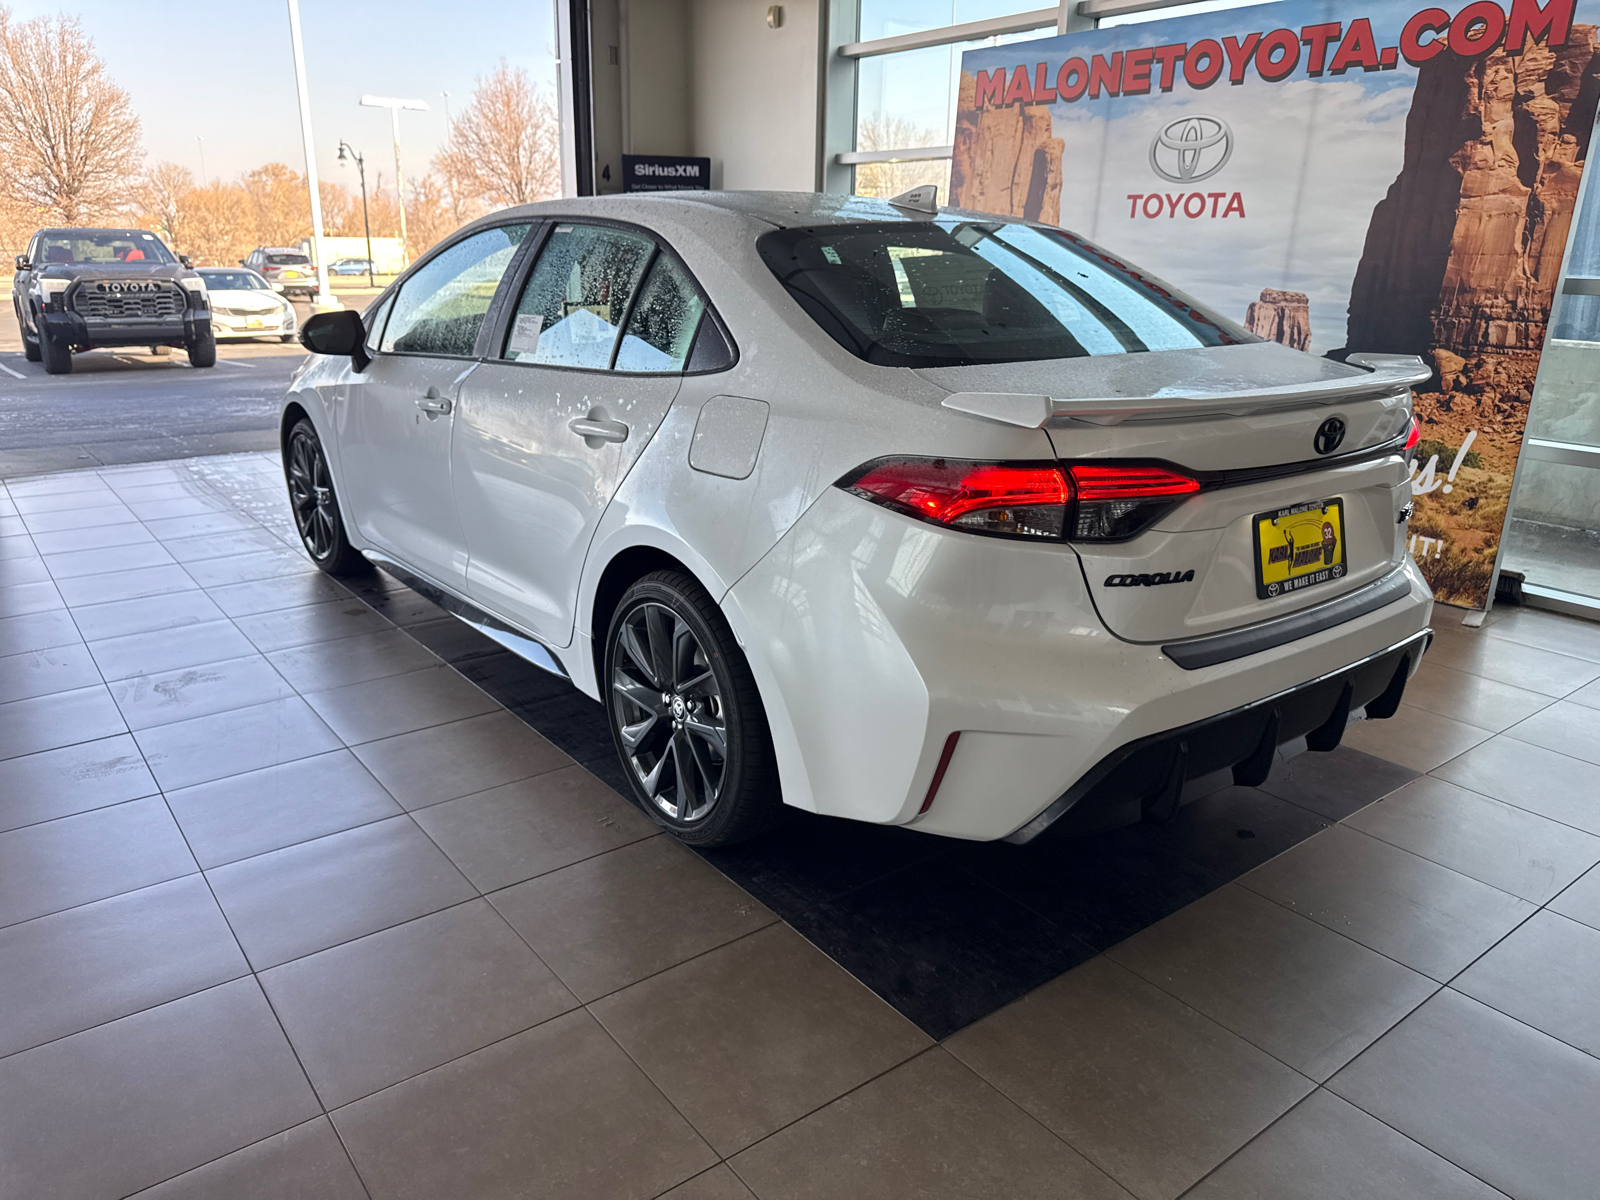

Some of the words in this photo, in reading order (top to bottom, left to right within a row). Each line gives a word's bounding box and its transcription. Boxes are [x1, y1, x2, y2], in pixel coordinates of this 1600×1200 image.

[974, 0, 1577, 110] MALONETOYOTA.COM
[602, 164, 611, 182] 4
[634, 163, 700, 178] SiriusXM
[1126, 192, 1246, 219] TOYOTA
[103, 282, 156, 293] TOYOTA
[1324, 527, 1333, 539] 32
[1268, 544, 1289, 565] KARL
[1292, 546, 1323, 568] MALONE
[1103, 569, 1196, 588] COROLLA
[1284, 581, 1292, 591] WE
[1293, 575, 1309, 589] MAKE
[1309, 574, 1315, 584] IT
[1315, 570, 1329, 581] EASY
